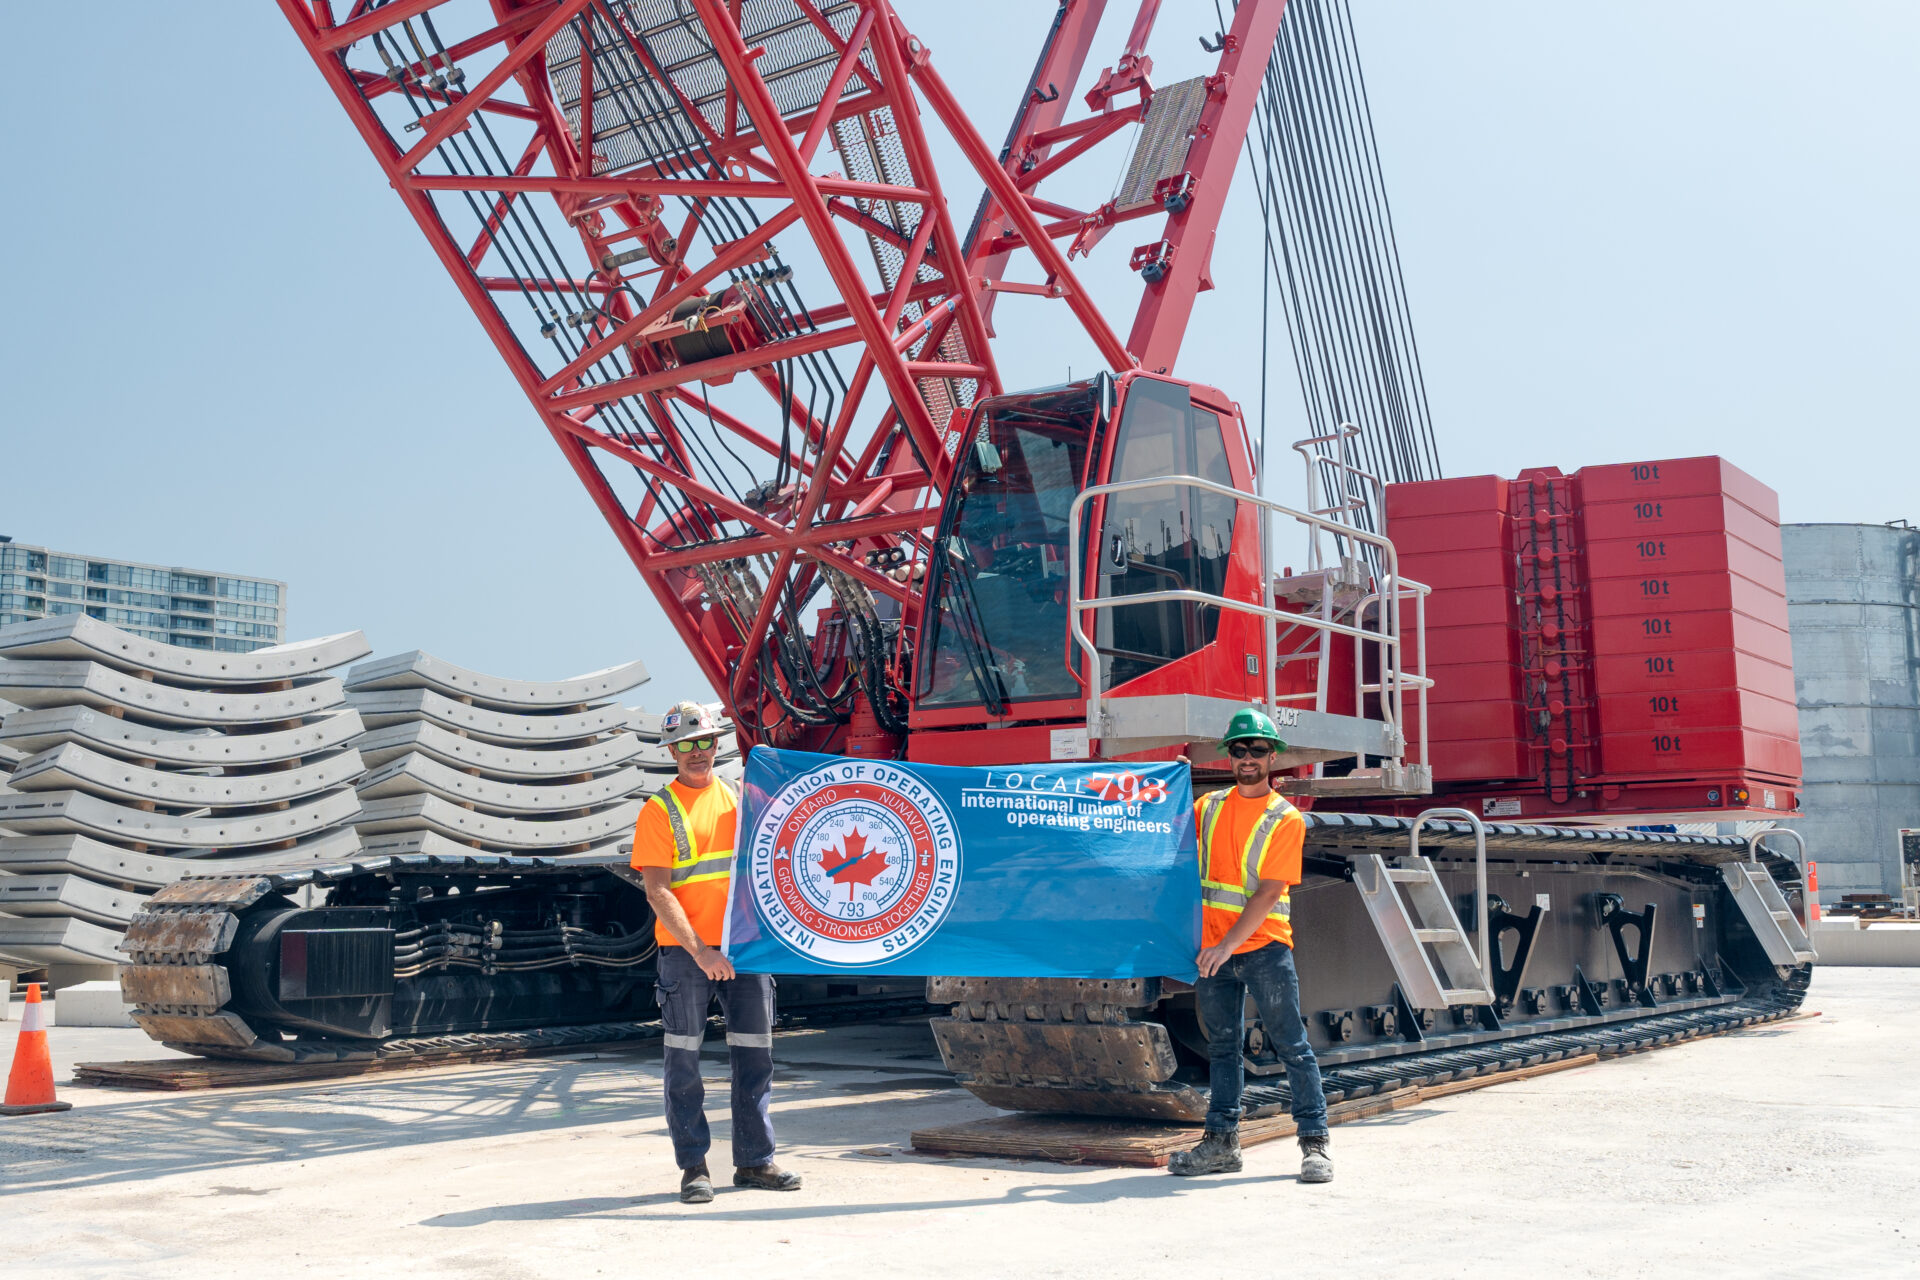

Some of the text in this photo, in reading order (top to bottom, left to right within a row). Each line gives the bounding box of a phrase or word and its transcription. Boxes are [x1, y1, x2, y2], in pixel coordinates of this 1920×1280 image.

[985, 772, 1167, 804] LOCAL 793
[961, 792, 1143, 818] international union of
[788, 789, 837, 832] ONTARIO
[850, 814, 865, 822] 300
[879, 792, 929, 842] NUNAVUT
[829, 819, 844, 828] 240
[868, 821, 883, 830] 360
[1007, 811, 1172, 834] operating engineers
[816, 833, 830, 841] 180
[882, 836, 897, 845] 420
[756, 766, 954, 952] INTERNATIONAL UNION OF OPERATING ENGINEERS
[808, 853, 822, 862] 120
[886, 856, 901, 865] 480
[811, 874, 821, 883] 60
[879, 877, 895, 886] 540
[862, 892, 878, 901] 600
[778, 867, 930, 937] GROWING STRONGER TOGETHER
[838, 901, 865, 918] 793
